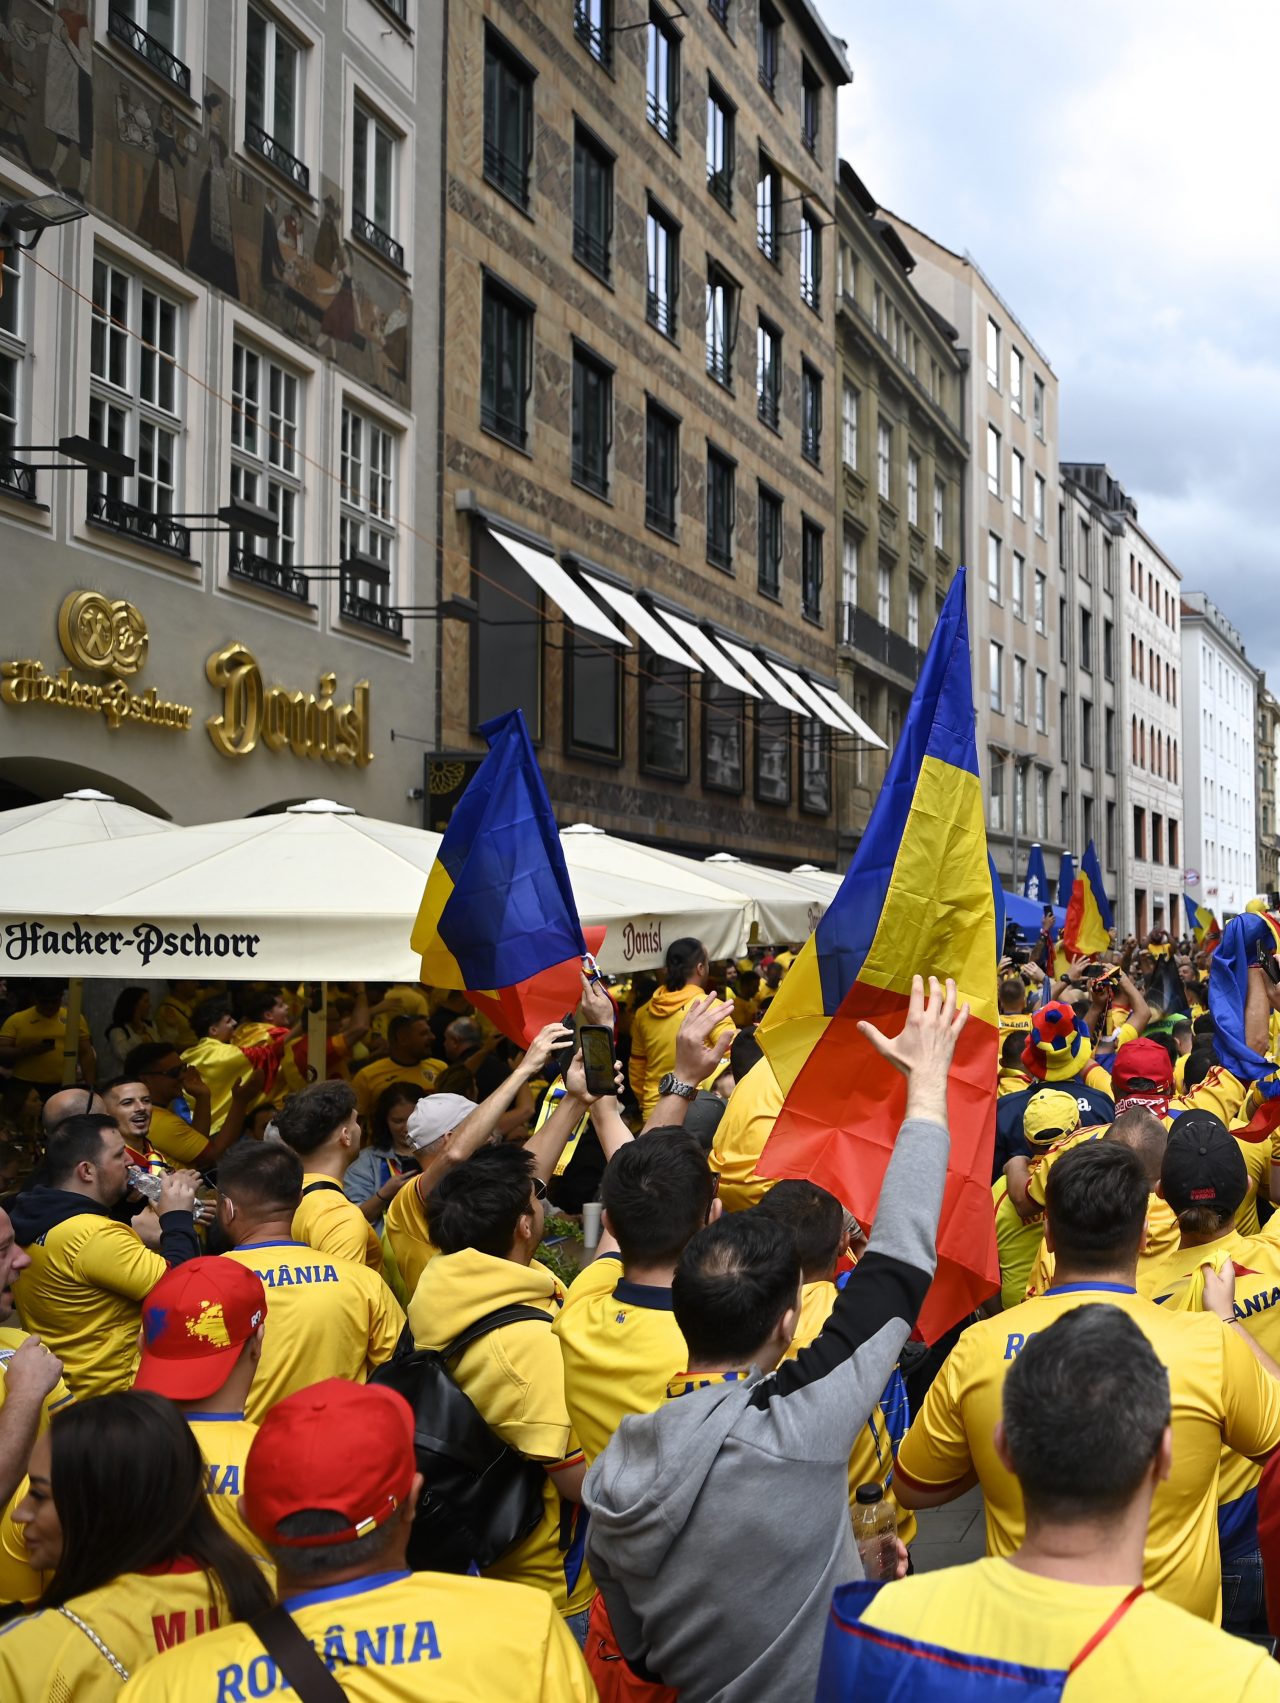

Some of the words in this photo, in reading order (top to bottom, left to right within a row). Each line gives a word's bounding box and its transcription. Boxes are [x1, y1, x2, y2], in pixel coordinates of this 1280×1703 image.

[206, 641, 374, 769] Donisl
[5, 921, 261, 966] Hacker-Pschorr
[623, 921, 662, 961] Donisl
[253, 1264, 339, 1288] MÂNIA
[216, 1621, 442, 1703] ROÂNIA
